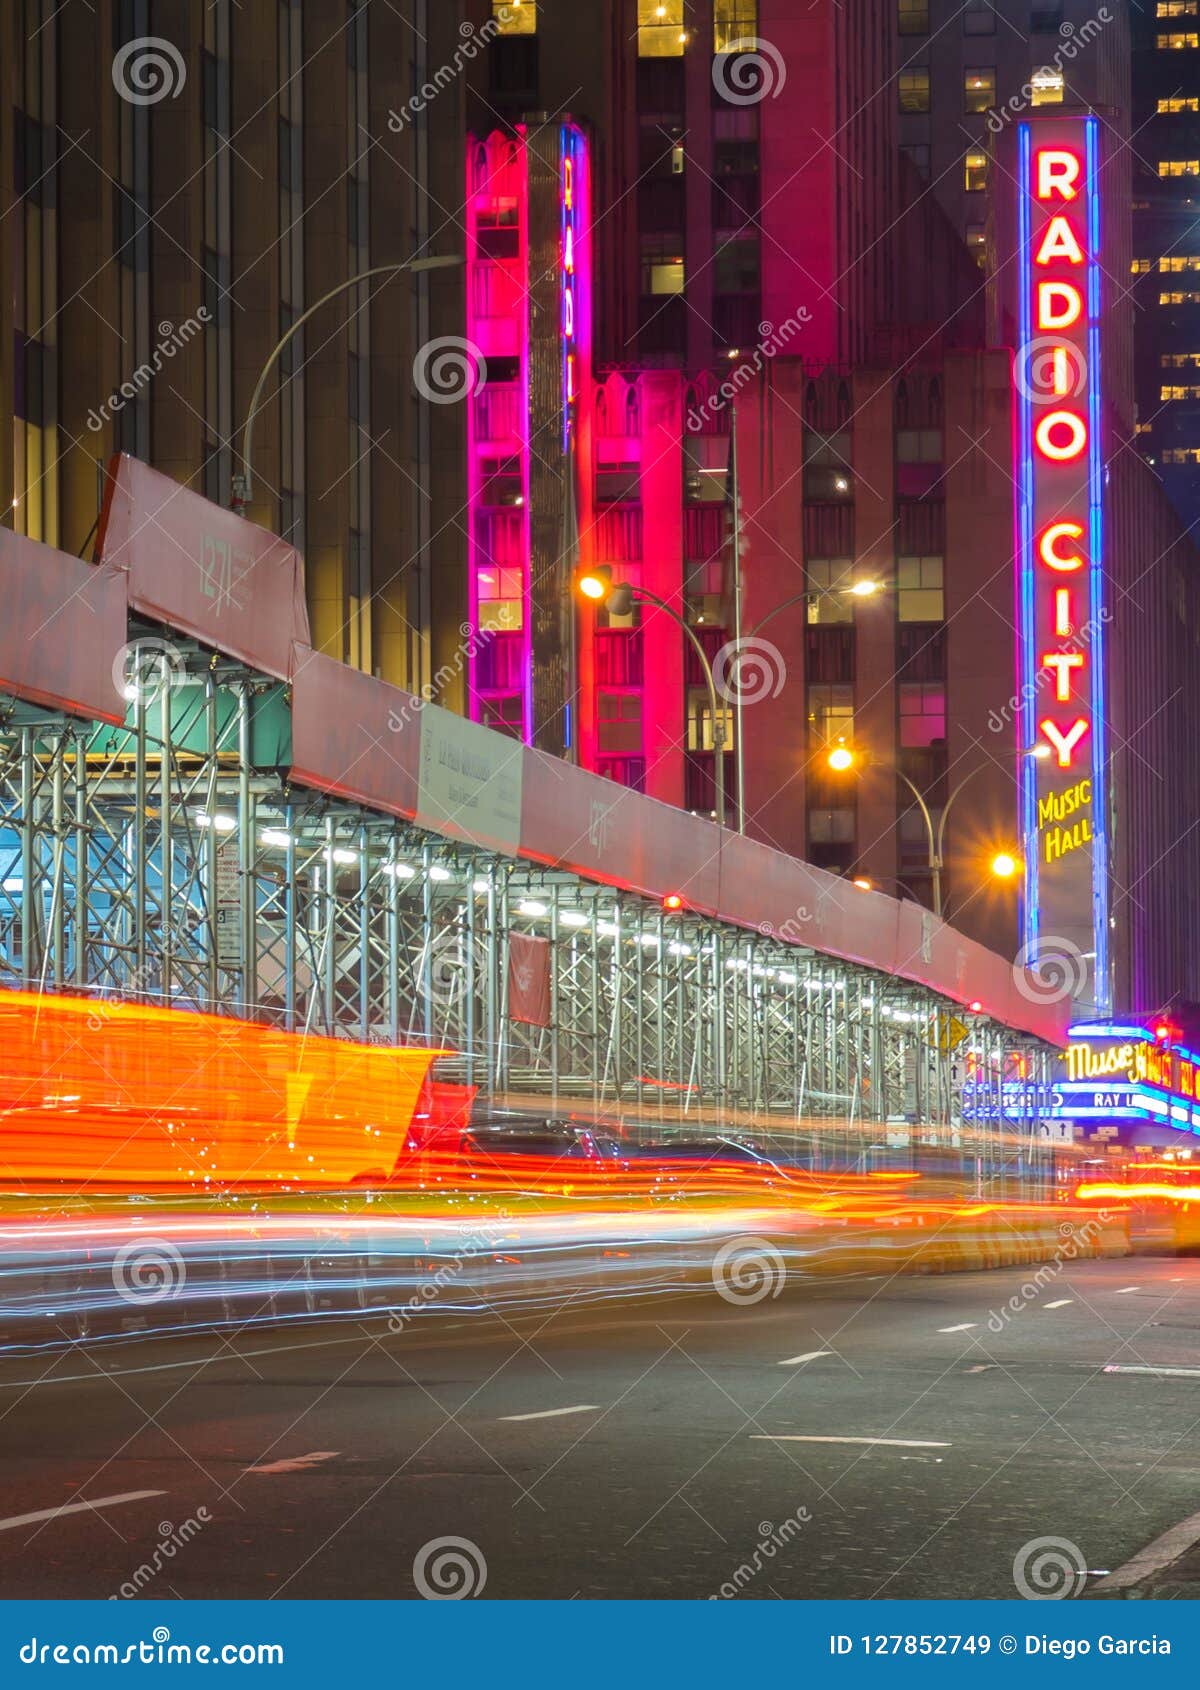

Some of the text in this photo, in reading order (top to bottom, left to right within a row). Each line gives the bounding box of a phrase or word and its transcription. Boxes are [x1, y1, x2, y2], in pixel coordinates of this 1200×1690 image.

[1036, 151, 1089, 767] RADIO CITY
[1038, 780, 1092, 830] MUSIC
[1045, 818, 1092, 863] HALL
[1094, 1093, 1120, 1107] RAY
